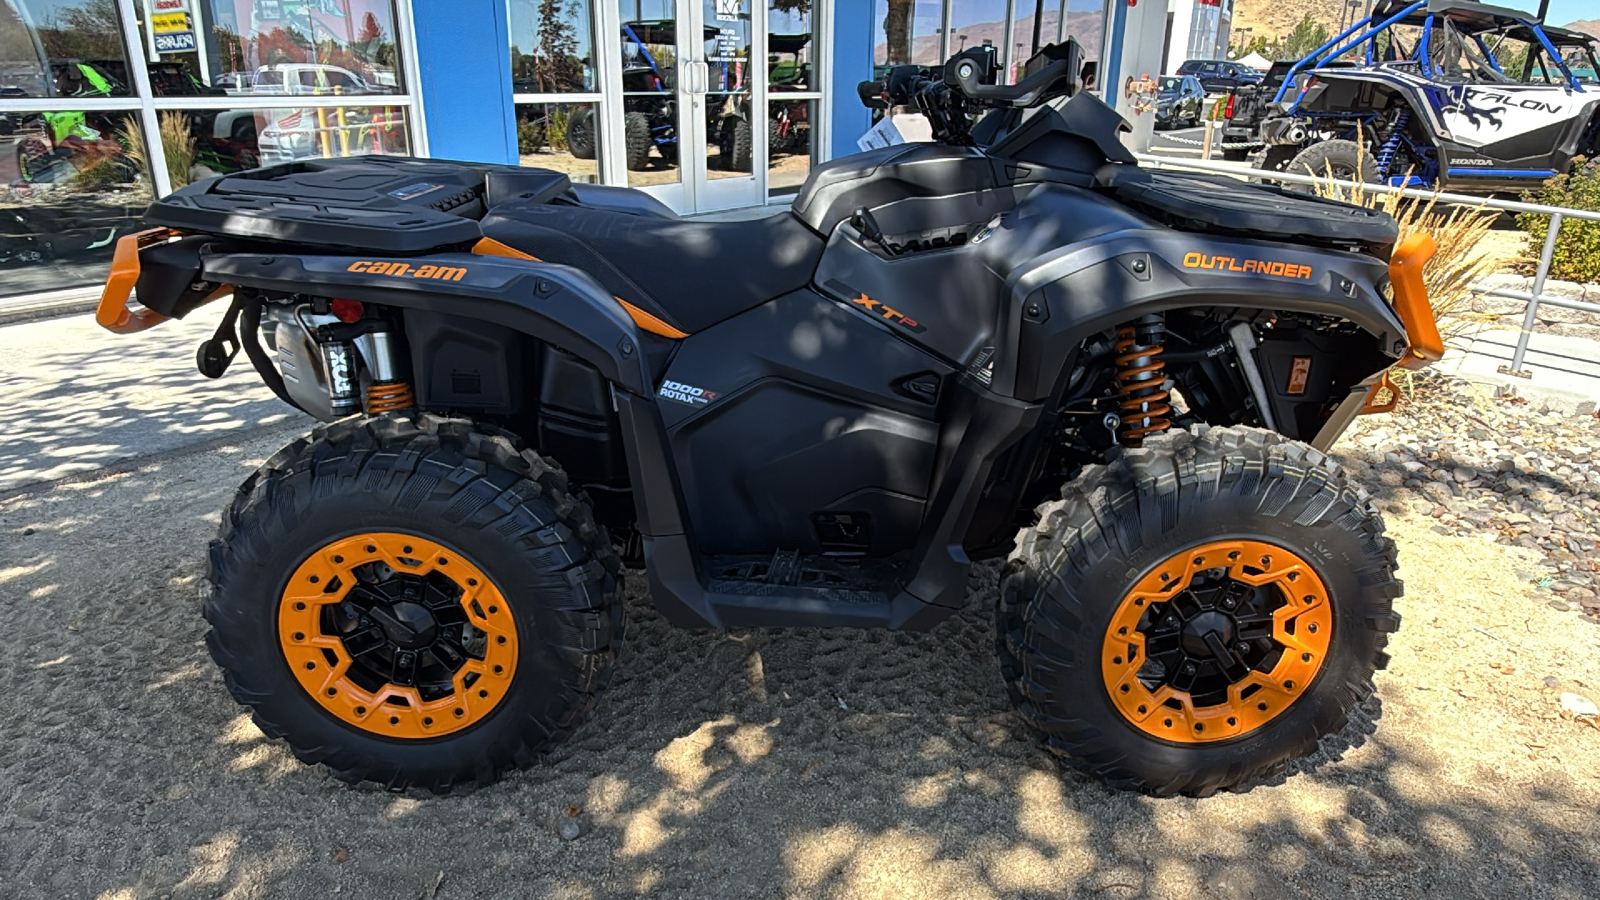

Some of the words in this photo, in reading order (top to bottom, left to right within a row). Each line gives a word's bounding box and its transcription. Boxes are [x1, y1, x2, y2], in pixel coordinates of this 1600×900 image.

[1467, 88, 1563, 114] TALON
[1450, 158, 1494, 166] HONDA
[347, 260, 468, 281] can-am
[1183, 252, 1312, 280] OUTLANDER
[329, 350, 352, 394] FOX
[660, 387, 694, 404] ROTAX
